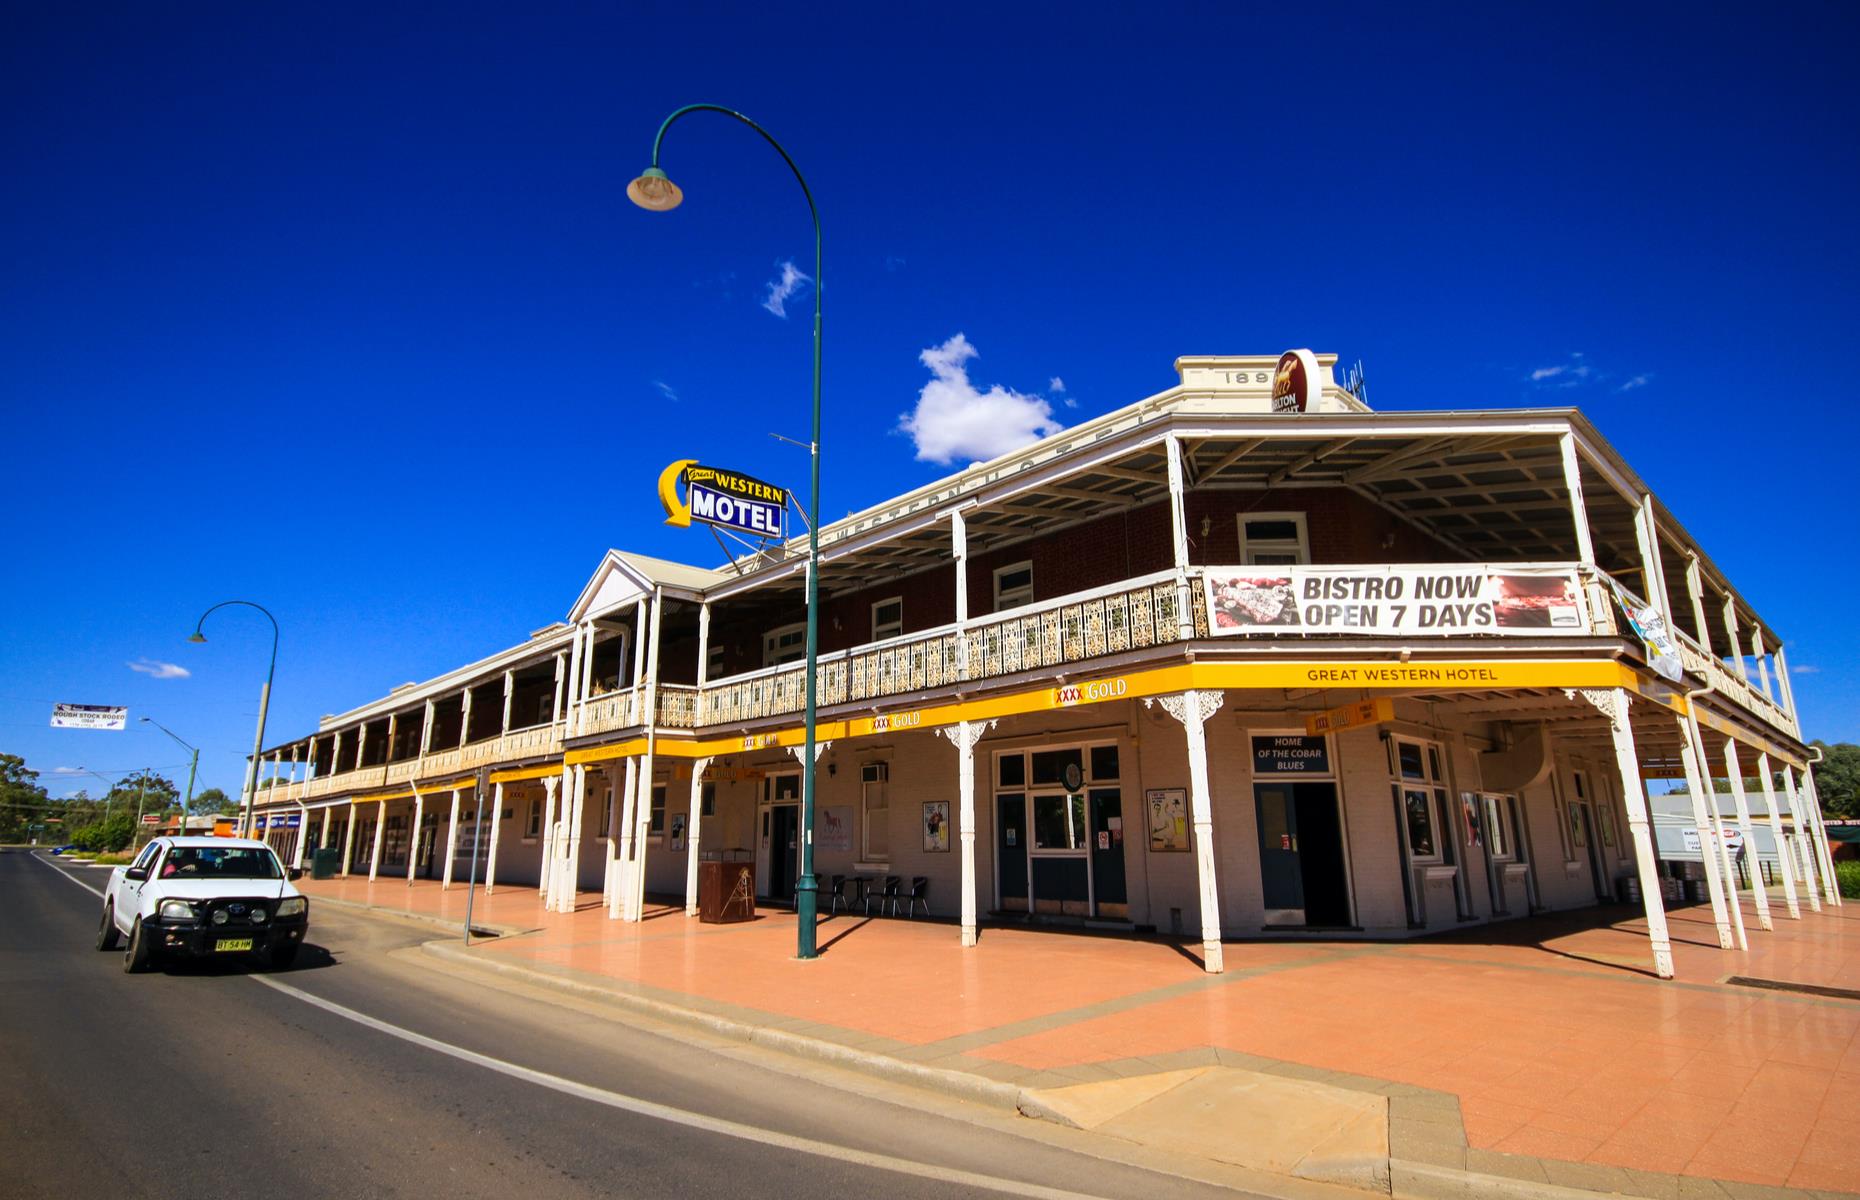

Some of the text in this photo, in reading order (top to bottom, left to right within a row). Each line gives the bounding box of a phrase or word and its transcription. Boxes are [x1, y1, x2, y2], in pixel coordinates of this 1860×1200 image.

[1226, 372, 1269, 384] 189
[688, 468, 783, 502] Great WESTERN
[693, 489, 779, 531] MOTEL
[1303, 575, 1482, 600] BISTRO NOW
[1304, 602, 1493, 628] OPEN 7 DAYS
[1307, 668, 1498, 681] GREAT WESTERN HOTEL
[1056, 679, 1127, 704] XXXX GOLD
[872, 711, 920, 730] XXXX GOLD
[1275, 738, 1302, 746] HOME
[1258, 749, 1322, 758] OF THE COBAR
[1277, 761, 1305, 770] BLUES
